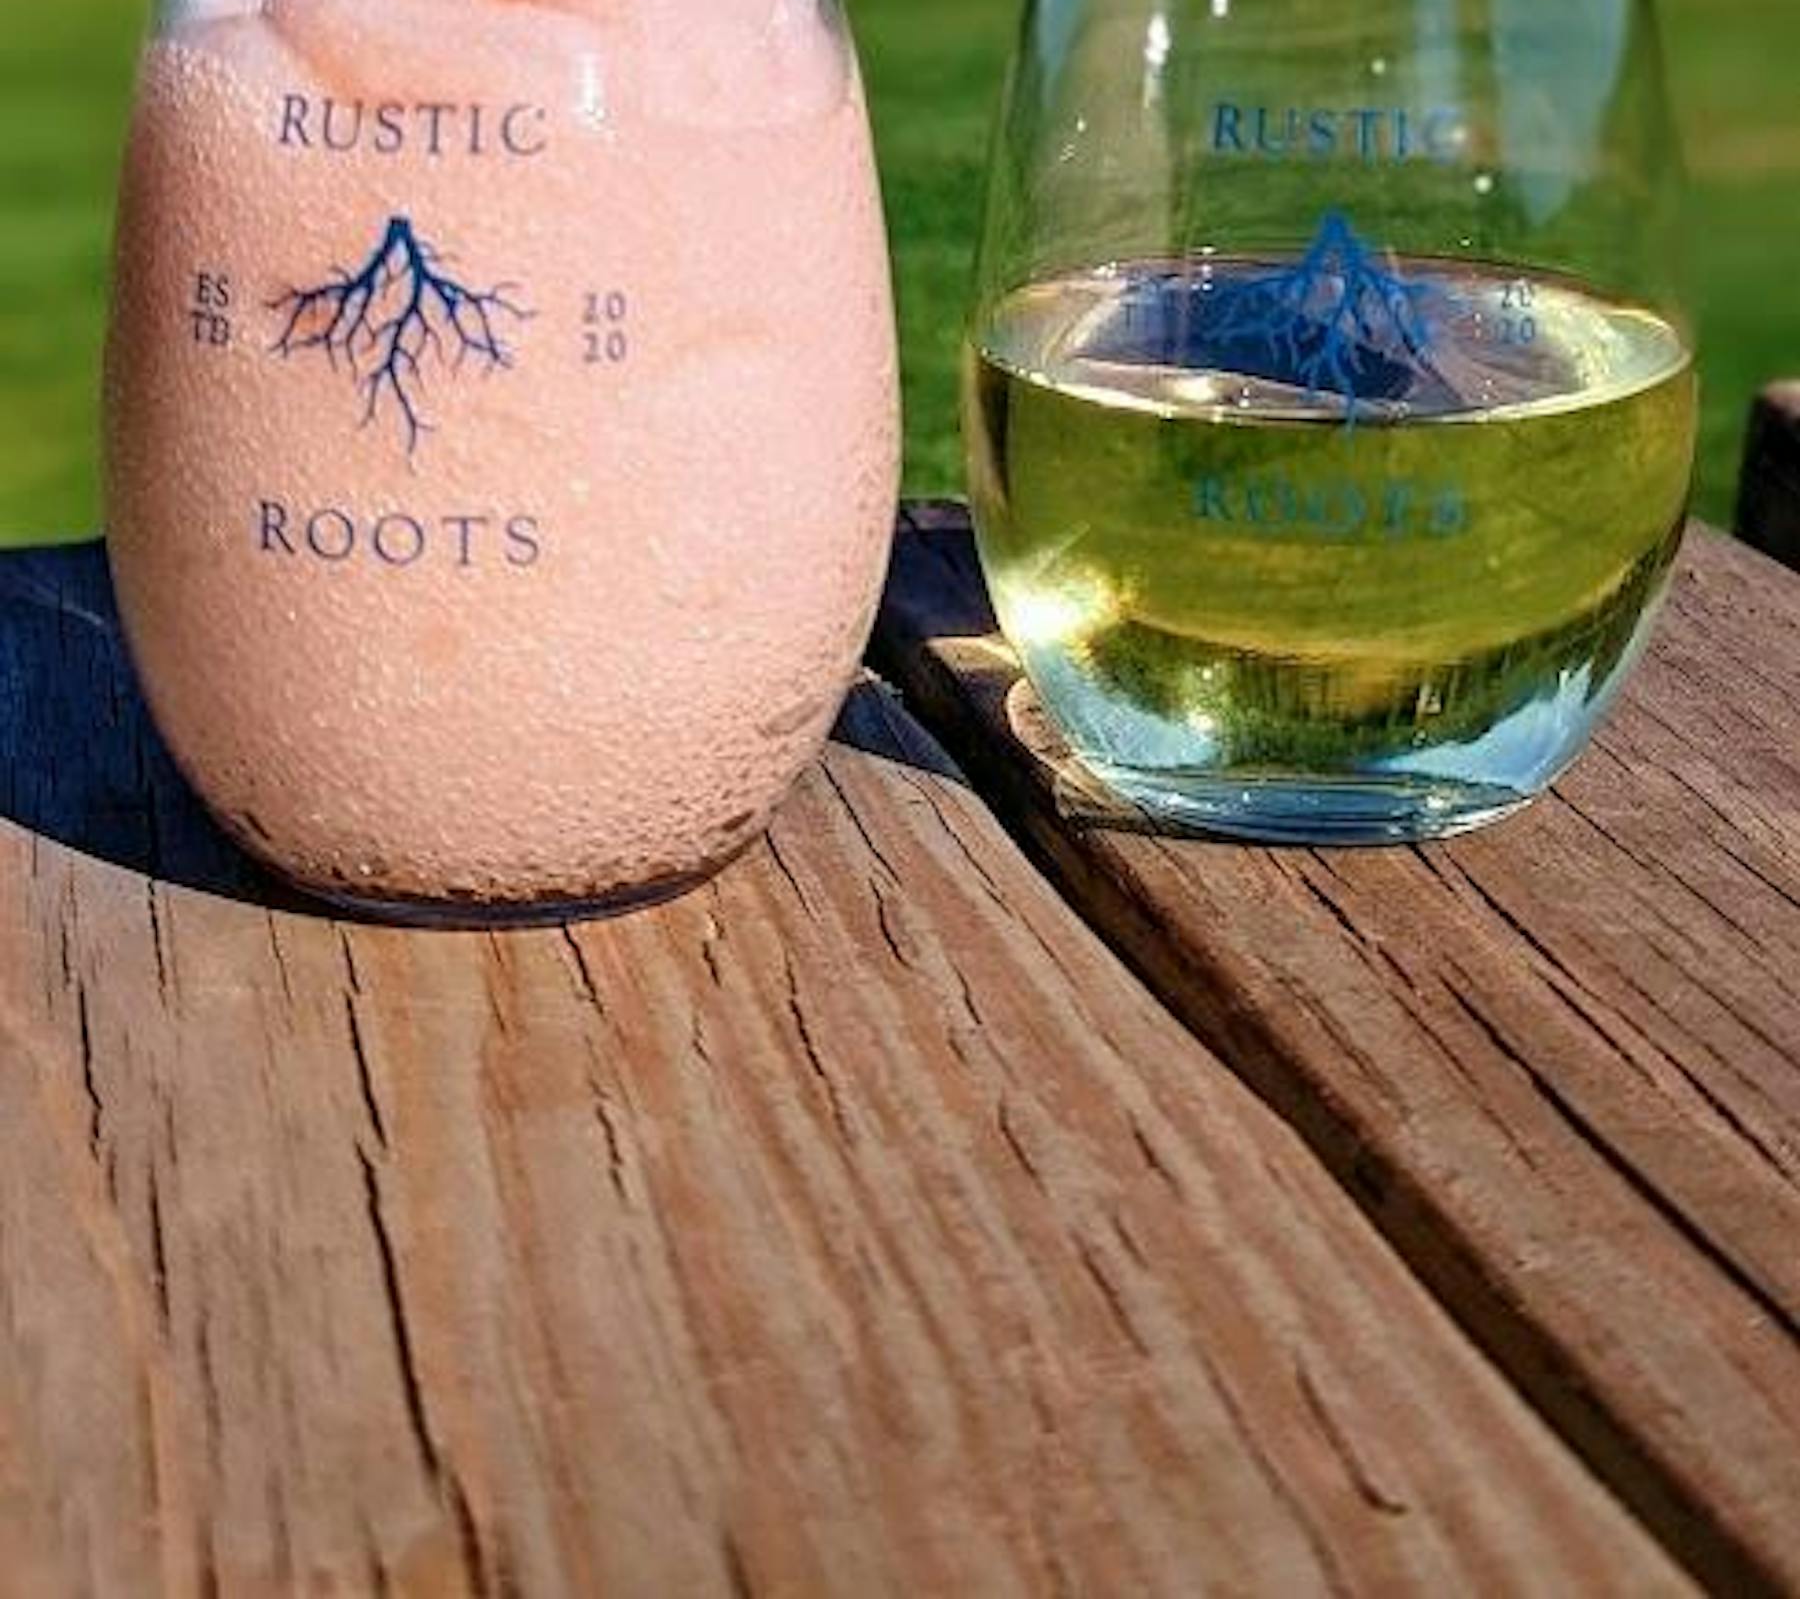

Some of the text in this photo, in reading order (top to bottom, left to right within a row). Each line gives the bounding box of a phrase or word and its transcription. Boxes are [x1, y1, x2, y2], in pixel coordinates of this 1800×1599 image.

[280, 93, 547, 156] RUSTIC
[1212, 103, 1466, 164] RUSTIC
[198, 272, 229, 307] ES
[257, 500, 541, 567] ROOTS
